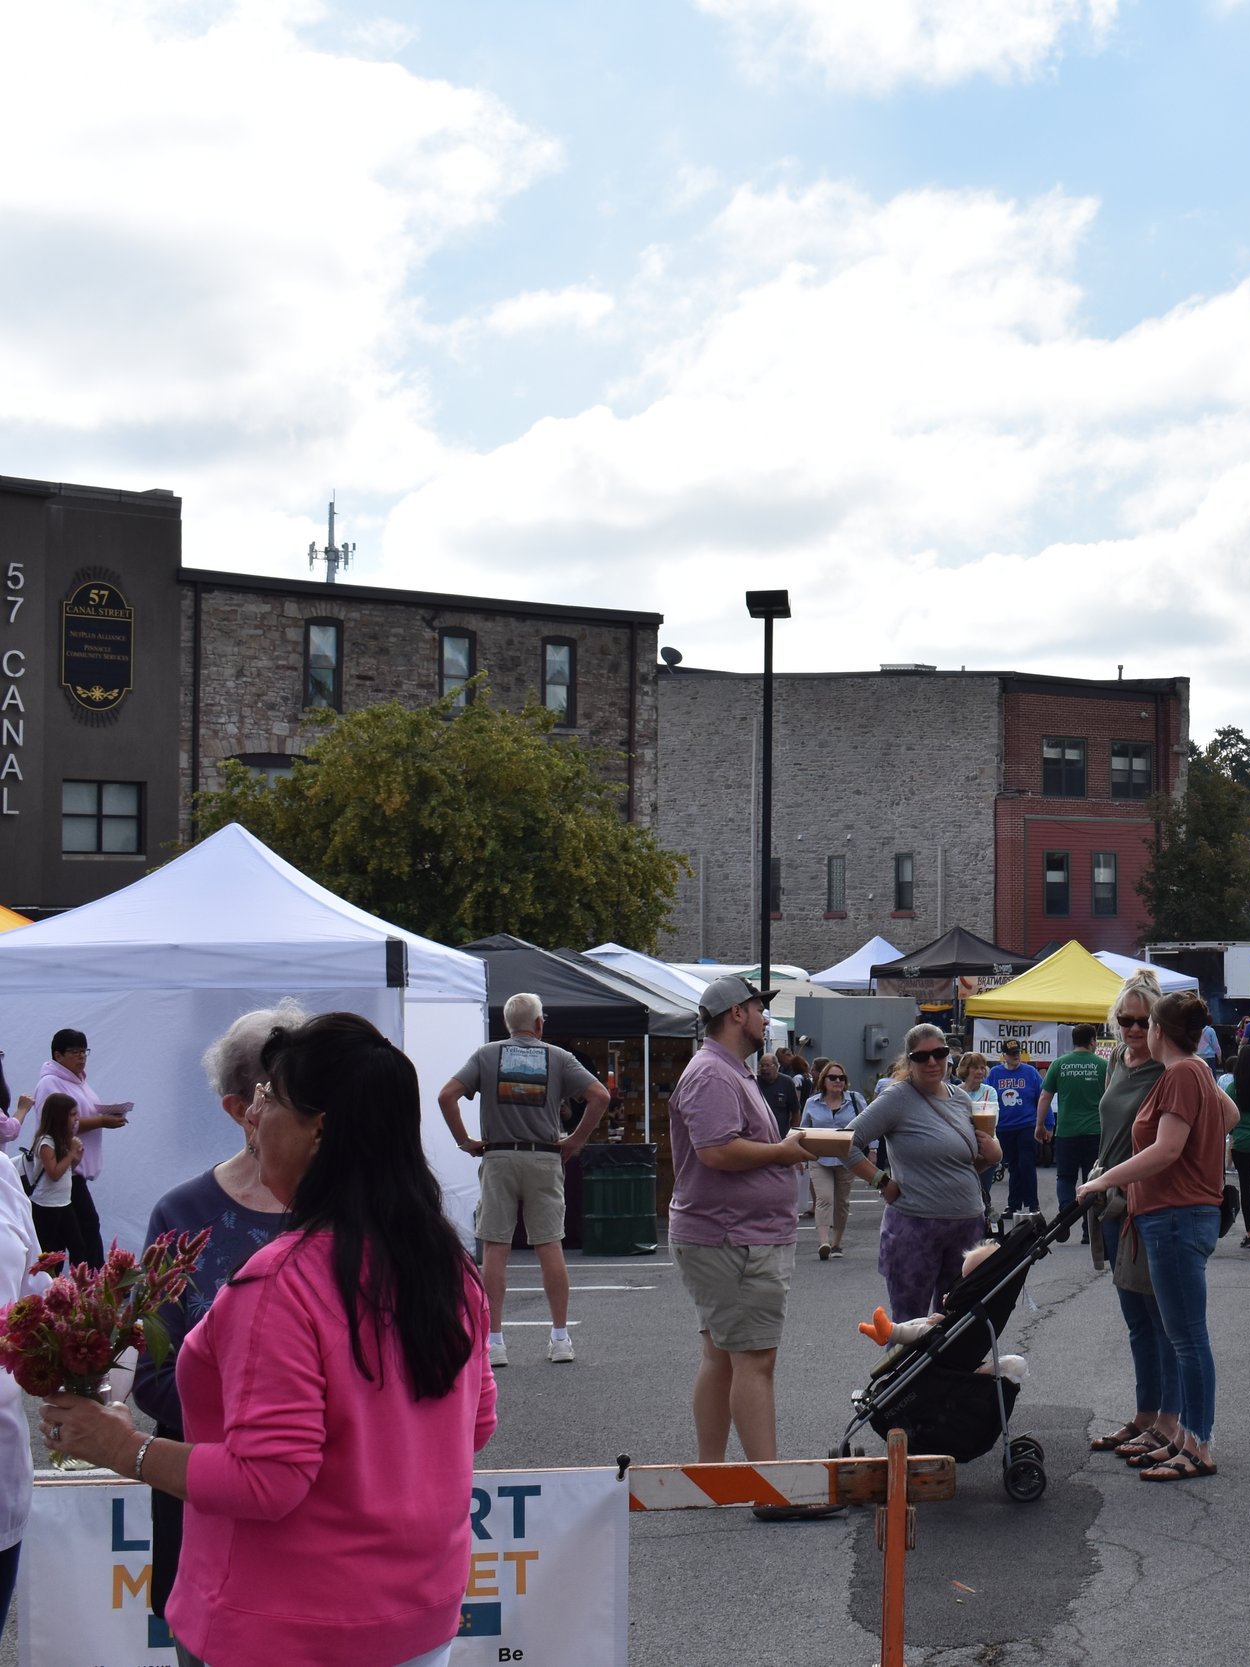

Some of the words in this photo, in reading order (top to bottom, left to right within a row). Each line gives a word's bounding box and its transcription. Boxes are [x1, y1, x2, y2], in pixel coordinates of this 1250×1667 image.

[89, 589, 109, 606] 57
[66, 605, 97, 615] CANAL
[98, 608, 130, 618] STREET
[0, 649, 26, 815] CANAL
[998, 1024, 1033, 1037] EVENT
[980, 1040, 1051, 1054] INFOATION
[1060, 1062, 1098, 1071] Community
[998, 1079, 1026, 1089] BFLO
[498, 1648, 524, 1662] Be
